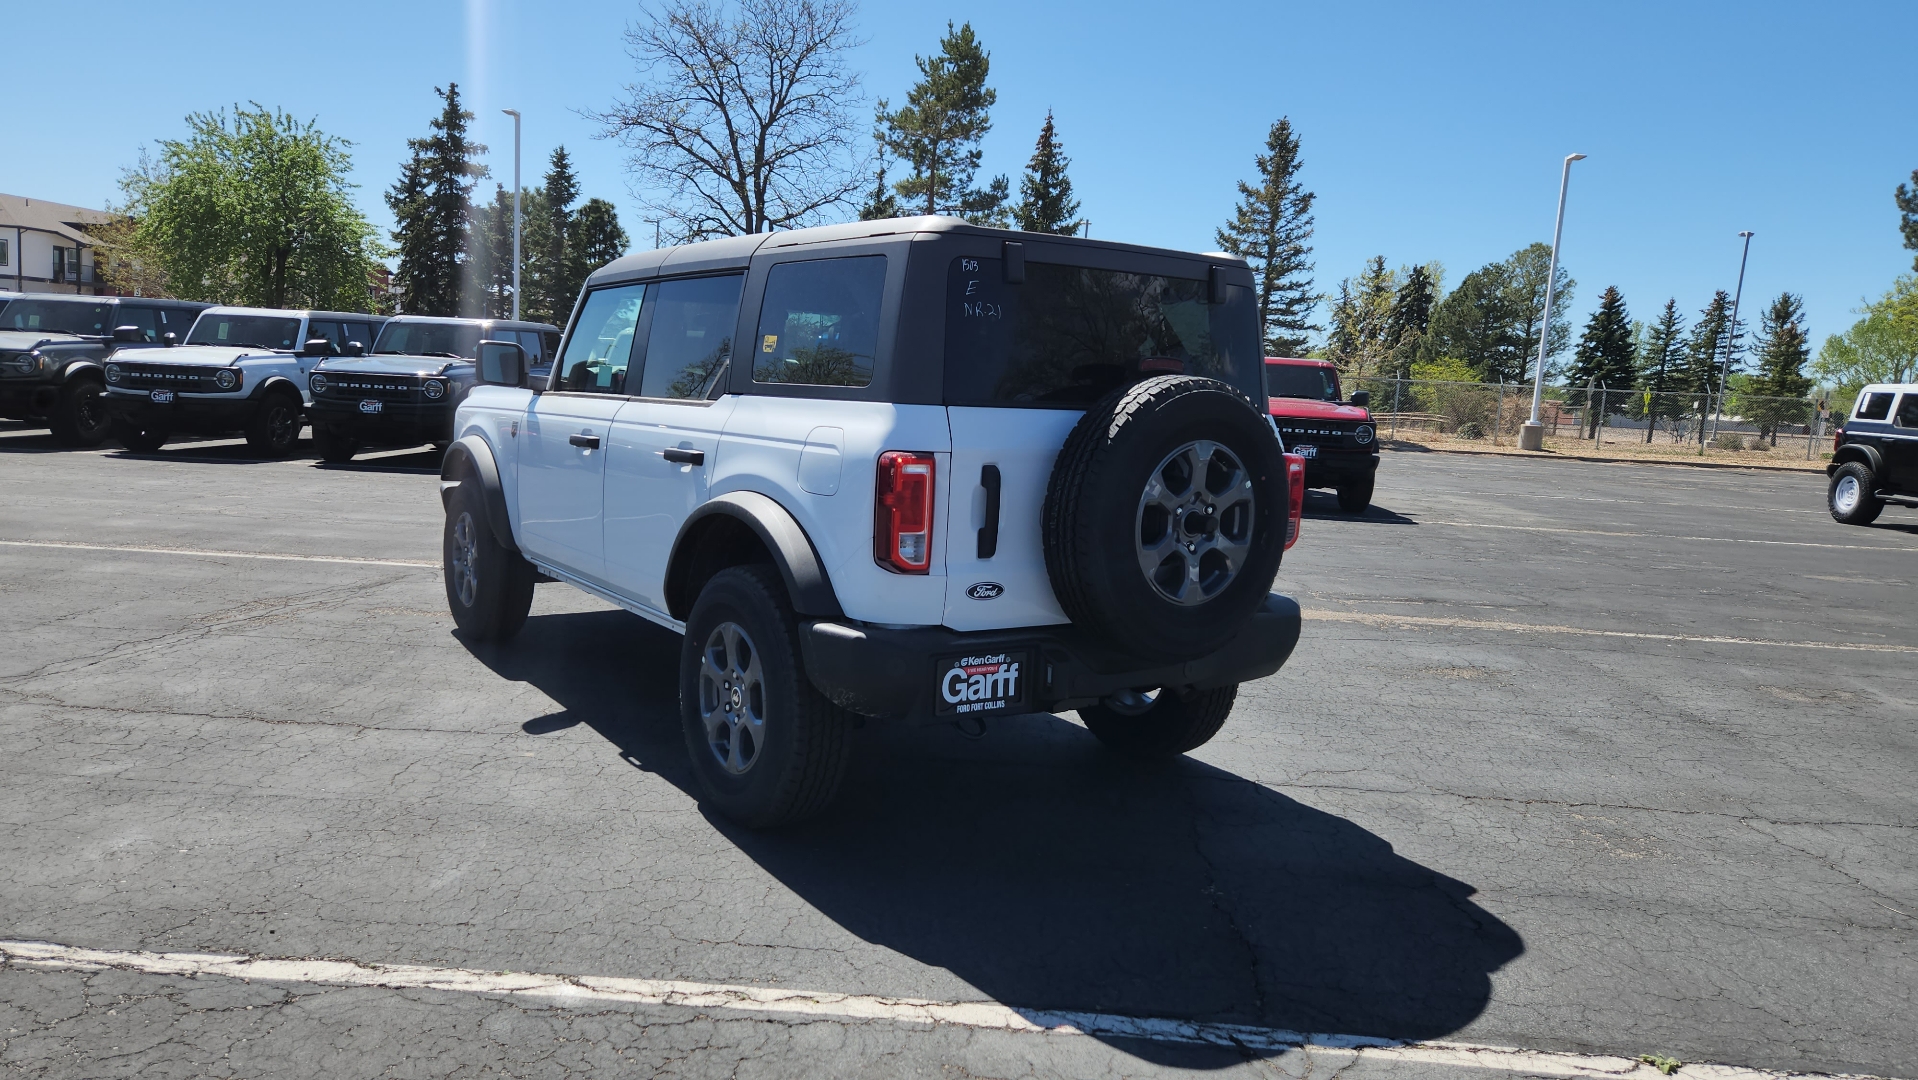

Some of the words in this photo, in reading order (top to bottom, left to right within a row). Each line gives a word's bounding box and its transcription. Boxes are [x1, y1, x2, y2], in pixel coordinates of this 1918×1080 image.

[965, 280, 980, 296] E
[130, 372, 199, 380] BRONCO
[338, 382, 407, 390] BRONCO
[151, 392, 174, 401] Garff
[359, 402, 382, 411] Garff
[1293, 447, 1317, 457] Garff
[973, 585, 998, 597] Ford
[968, 656, 984, 666] Ken
[985, 654, 1005, 664] Garff
[942, 663, 1019, 703] Garff
[956, 704, 970, 713] FORD
[970, 702, 984, 712] FORT
[984, 699, 1005, 710] COLLINS
